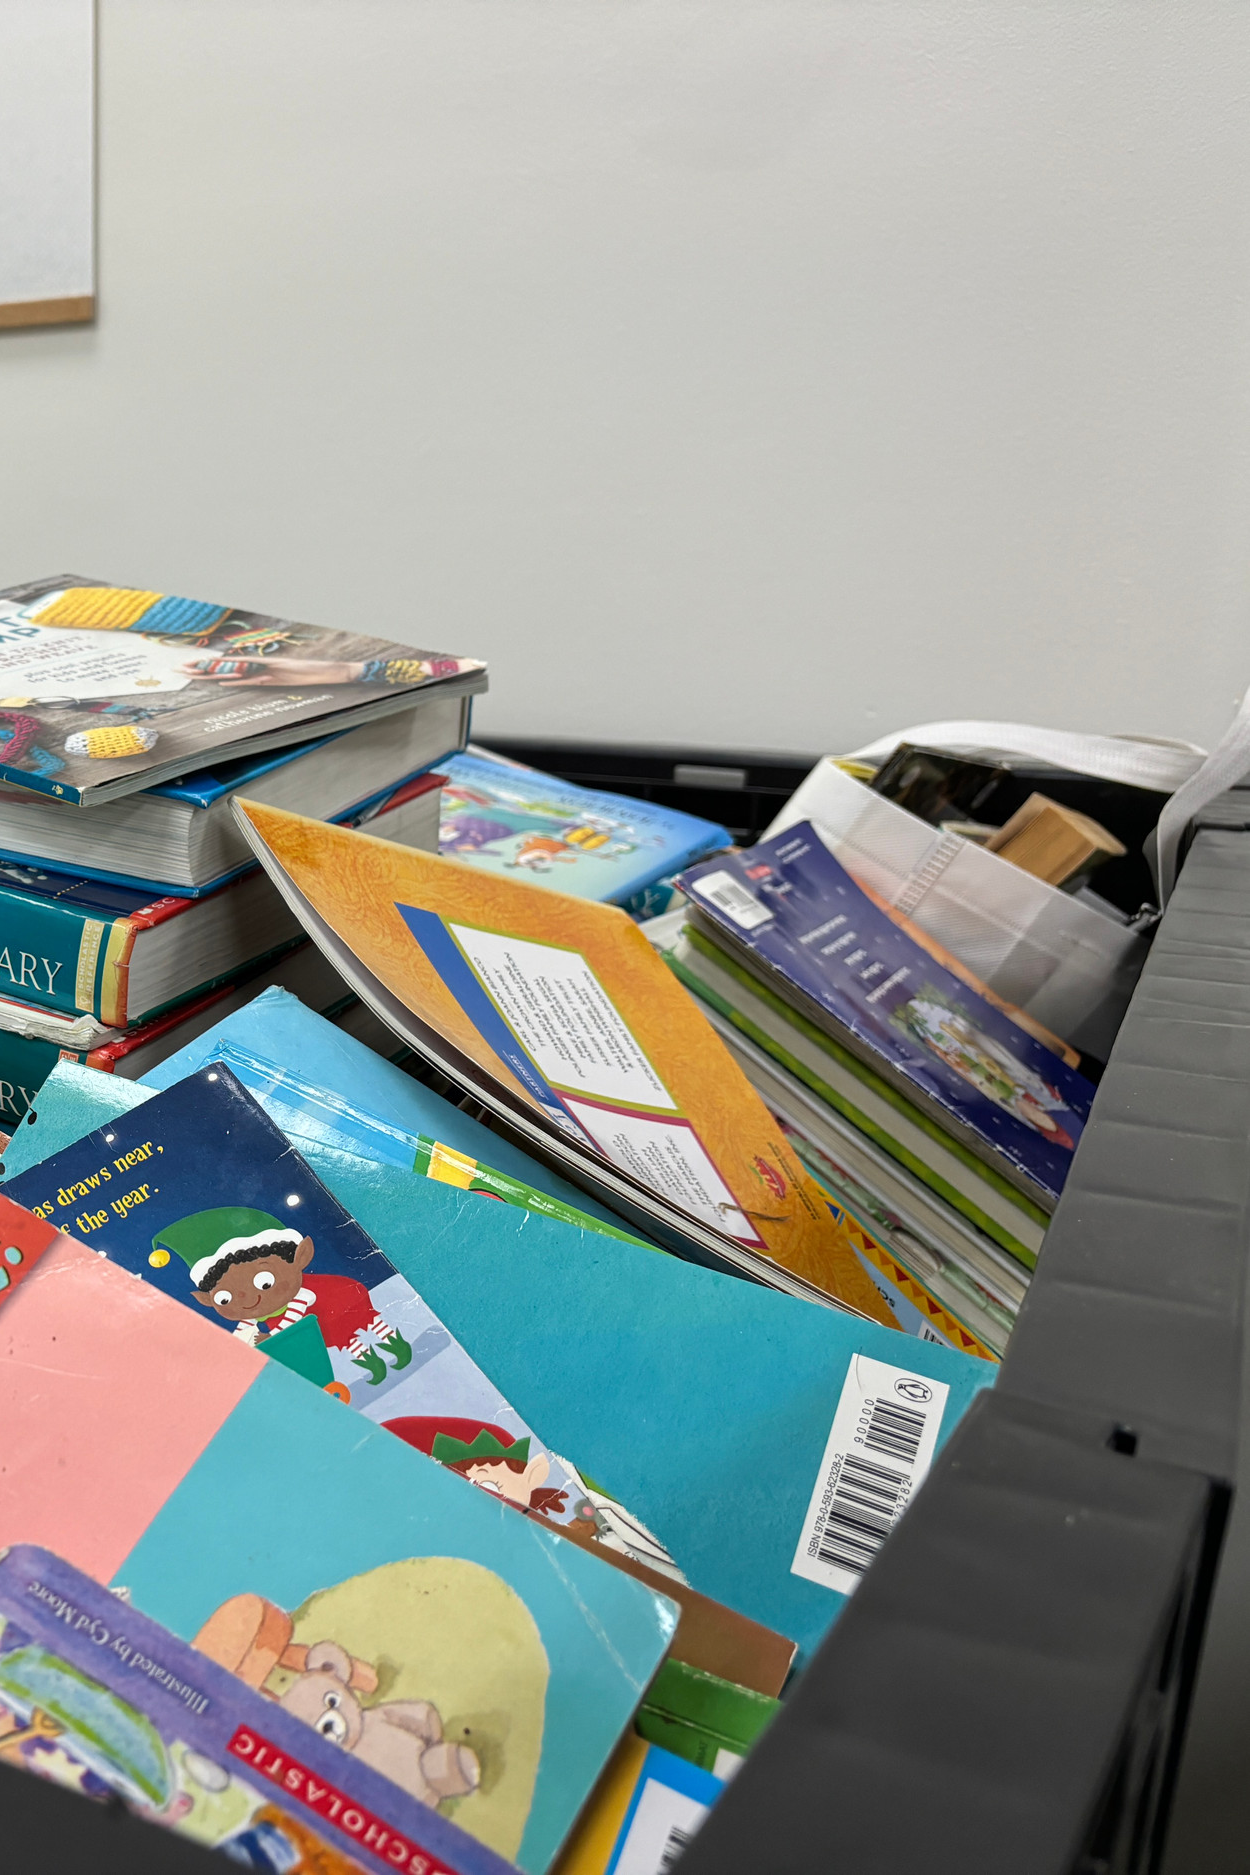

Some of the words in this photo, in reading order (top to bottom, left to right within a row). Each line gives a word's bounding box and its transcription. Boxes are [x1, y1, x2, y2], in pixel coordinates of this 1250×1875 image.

[78, 924, 93, 991] SCHOLASTIC
[86, 926, 101, 995] REFERENCE
[57, 1167, 112, 1206] draws
[113, 1141, 163, 1173] near,
[76, 1210, 109, 1233] the
[111, 1183, 159, 1218] year.
[854, 1399, 875, 1444] 90000
[807, 1535, 820, 1557] ISBN
[817, 1453, 844, 1533] 978-0-593-62328-2
[28, 1581, 77, 1624] Moore
[74, 1614, 110, 1645] Cyd
[110, 1636, 132, 1661] by
[129, 1653, 210, 1715] Illustrated
[235, 1733, 429, 1875] SCHOLASTIC
